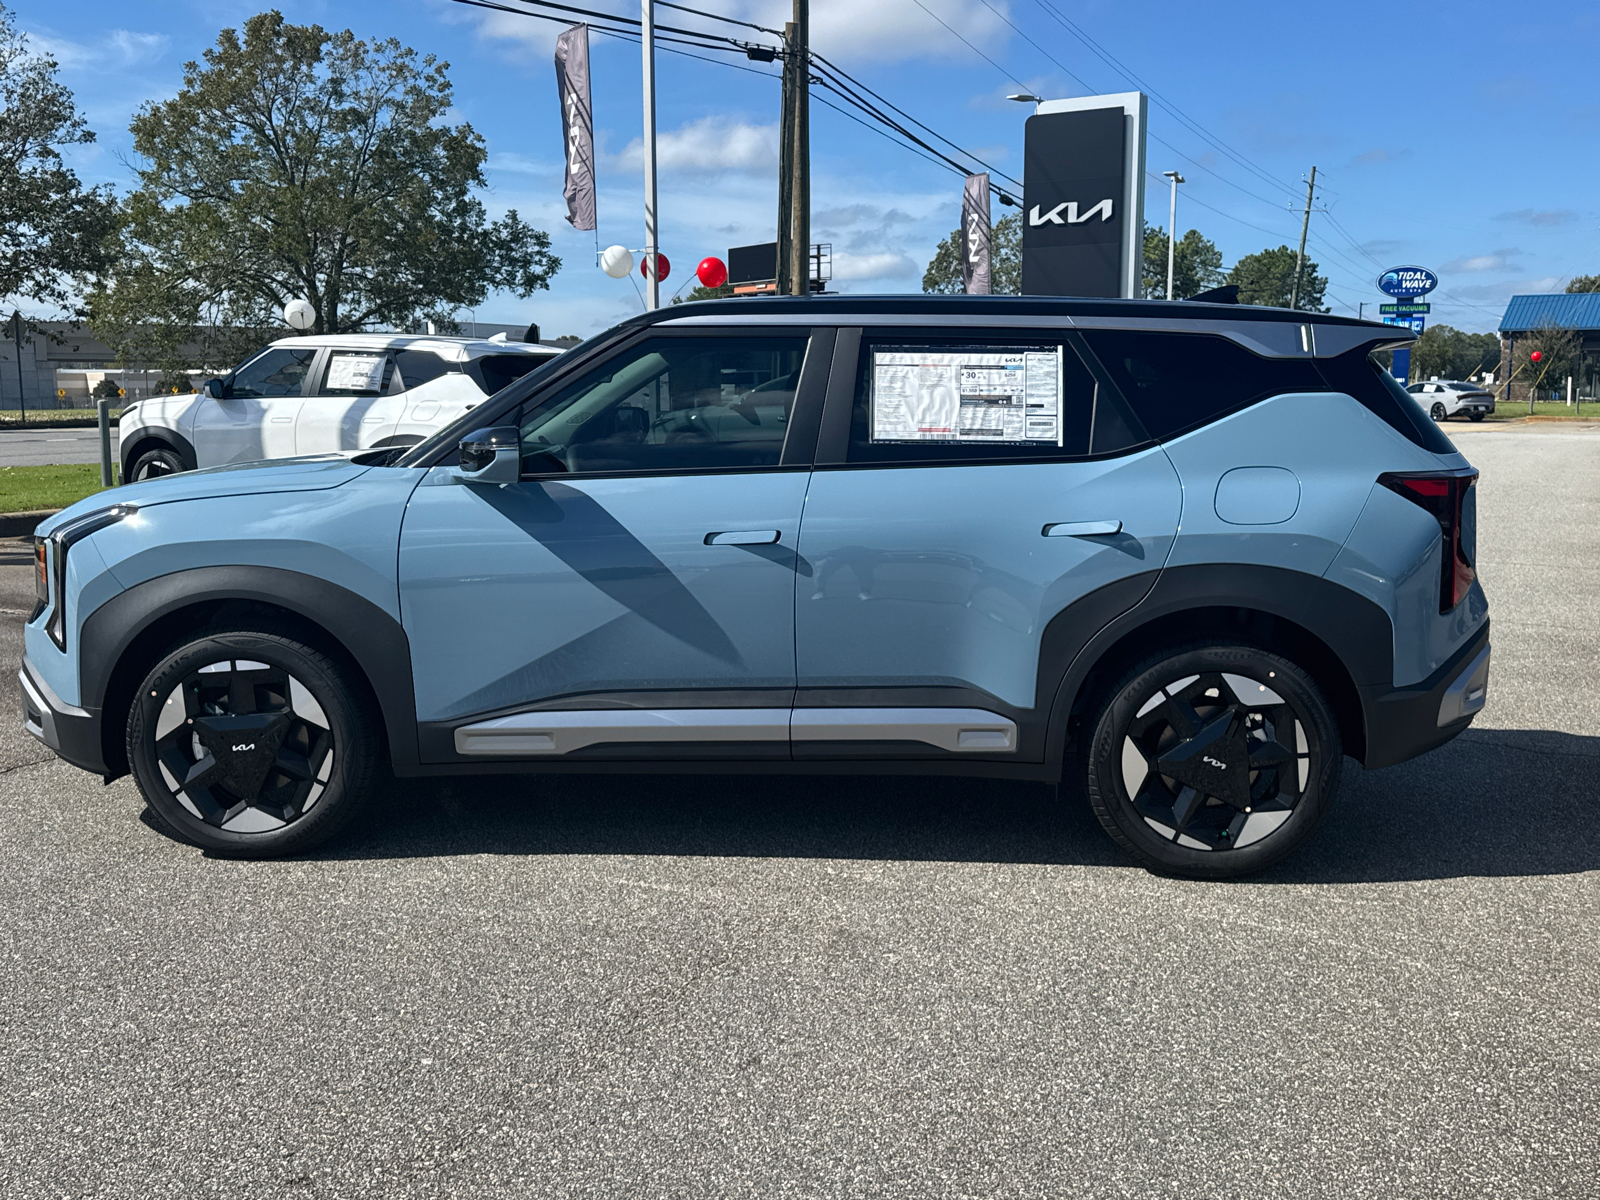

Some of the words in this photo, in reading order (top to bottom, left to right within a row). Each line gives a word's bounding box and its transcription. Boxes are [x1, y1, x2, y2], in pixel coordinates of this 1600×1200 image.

[1029, 198, 1113, 226] KIA
[1398, 272, 1426, 280] TIDAL
[1402, 280, 1432, 288] WAVE
[1121, 658, 1180, 703] KUMHO
[284, 802, 336, 845] KUMHO
